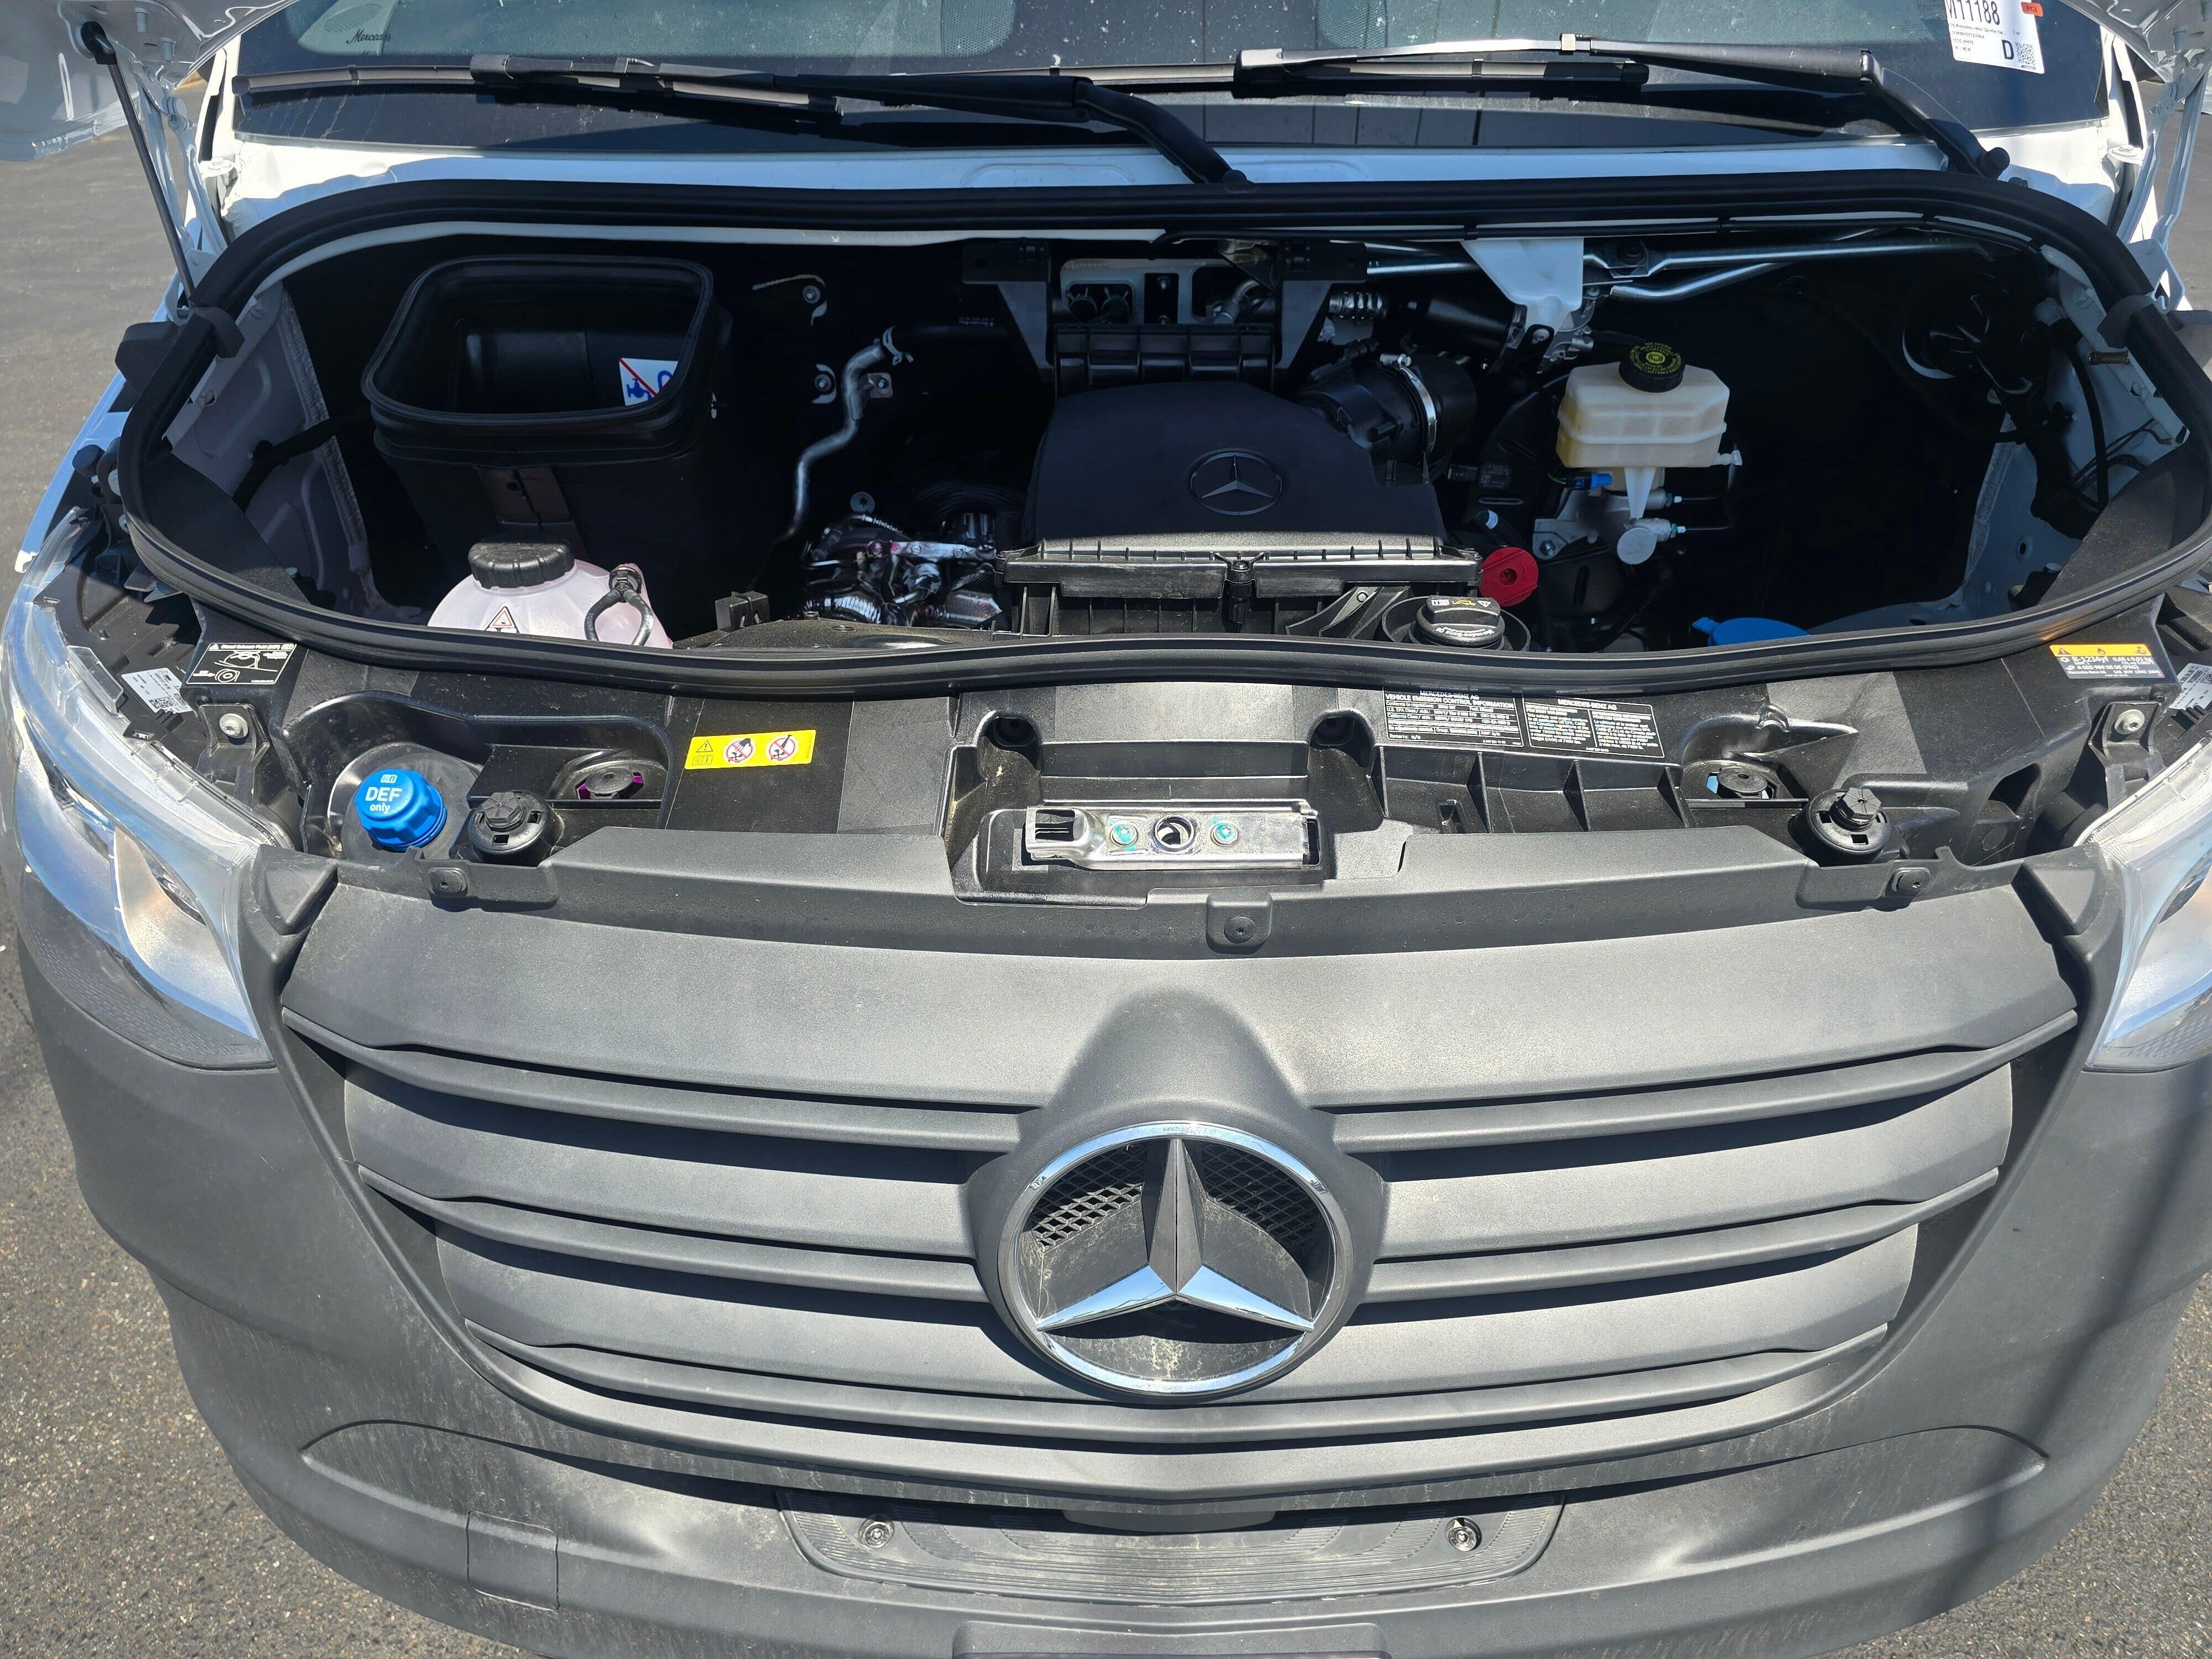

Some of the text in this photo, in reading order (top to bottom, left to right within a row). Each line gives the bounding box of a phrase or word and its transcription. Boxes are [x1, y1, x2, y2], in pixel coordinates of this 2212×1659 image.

[2001, 39, 2014, 60] D
[1420, 690, 1469, 699] MERCEDES-BENZ
[1473, 700, 1514, 708] INFORMATION
[1558, 699, 1607, 709] MERCEDES-BENZ
[365, 786, 403, 802] DEF
[369, 802, 391, 815] only
